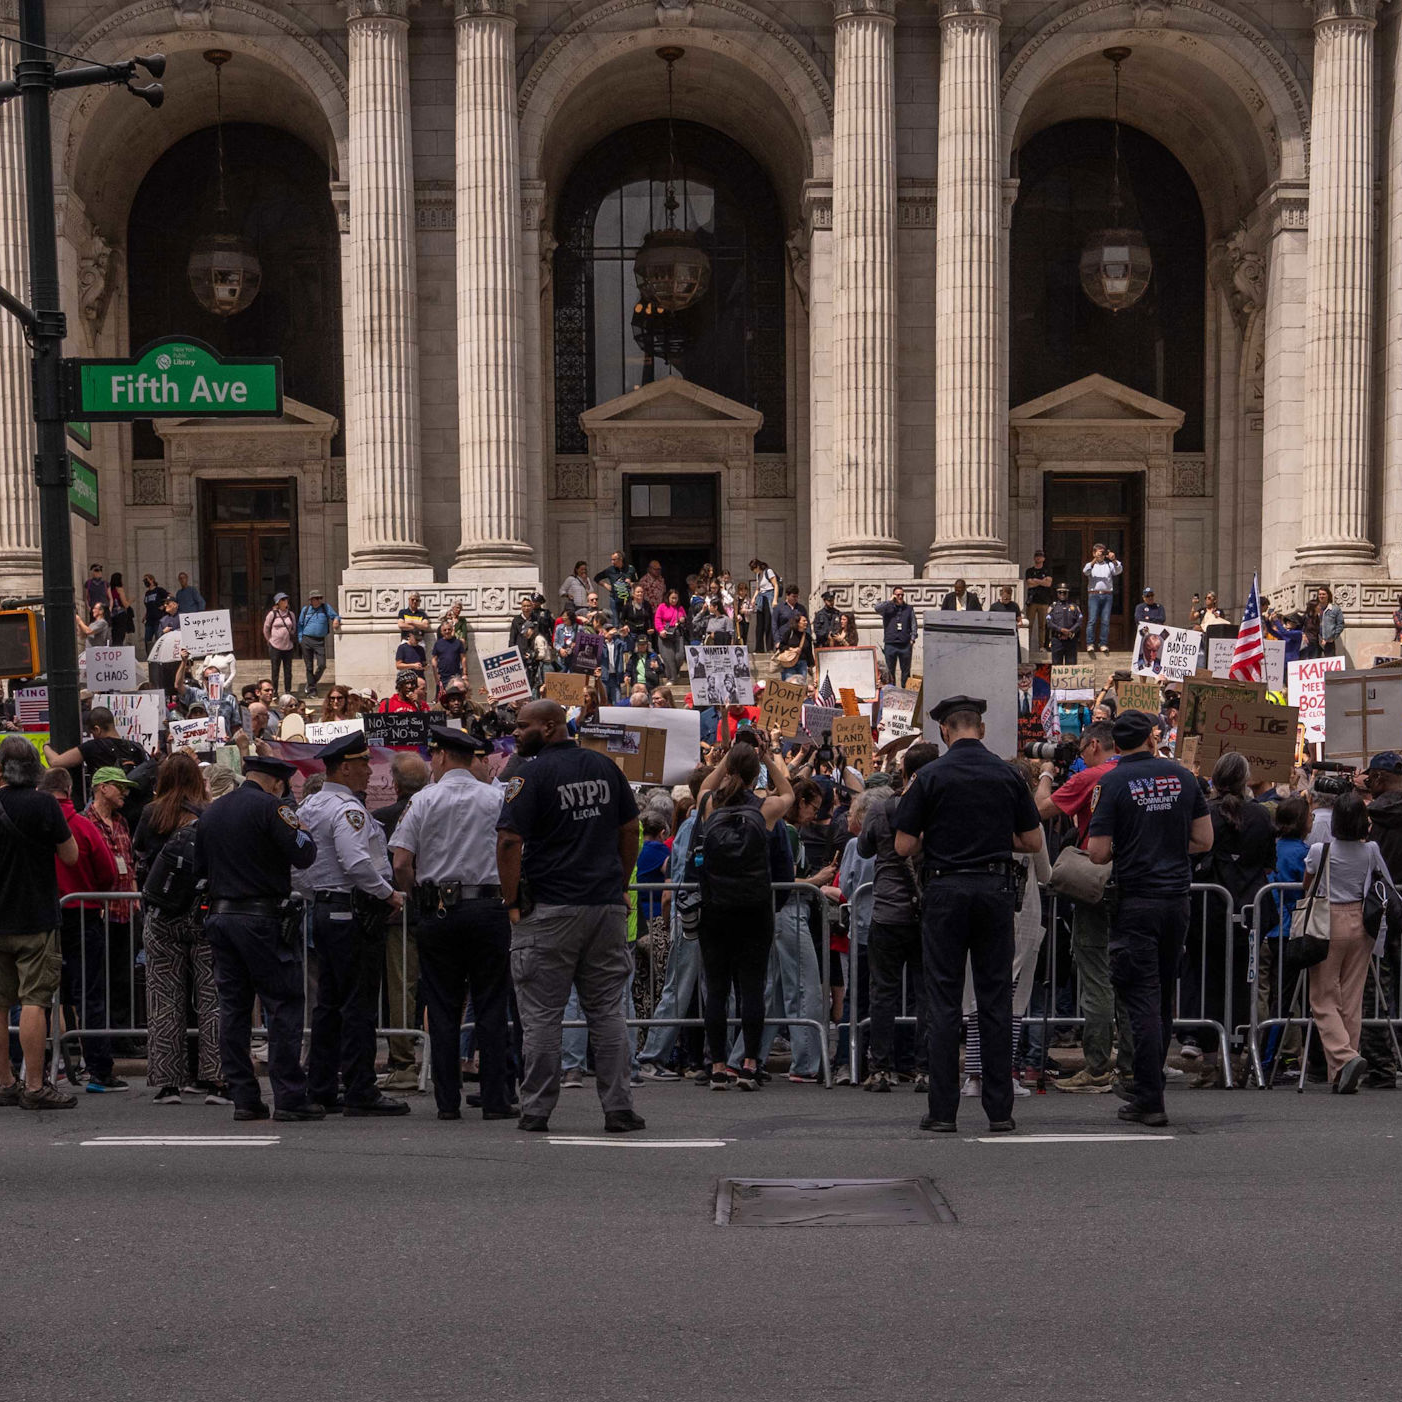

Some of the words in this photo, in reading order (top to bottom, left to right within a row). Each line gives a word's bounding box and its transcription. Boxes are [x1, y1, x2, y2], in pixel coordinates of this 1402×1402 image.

[111, 374, 179, 403] Fifth
[190, 375, 248, 403] Ave
[184, 616, 220, 627] Support
[1175, 631, 1187, 643] NO
[1167, 641, 1181, 653] BAD
[1182, 643, 1196, 656] DEED
[94, 651, 122, 661] STOP
[1169, 656, 1187, 667] GOES
[96, 670, 129, 682] CHAOS
[486, 663, 523, 680] RESISTANCE
[502, 675, 511, 684] IS
[491, 679, 527, 695] PATRIOTISM
[1124, 684, 1159, 699] HOME
[764, 698, 799, 719] Give
[1120, 697, 1160, 711] GROWN
[309, 725, 323, 737] THE
[326, 723, 349, 735] ONLY
[1254, 715, 1289, 735] ICE
[1128, 775, 1181, 800] NYPD
[557, 779, 611, 811] NYPD
[1137, 795, 1178, 806] COMMUNITY
[572, 806, 601, 820] LEGAL
[1146, 803, 1172, 812] AFFAIRS
